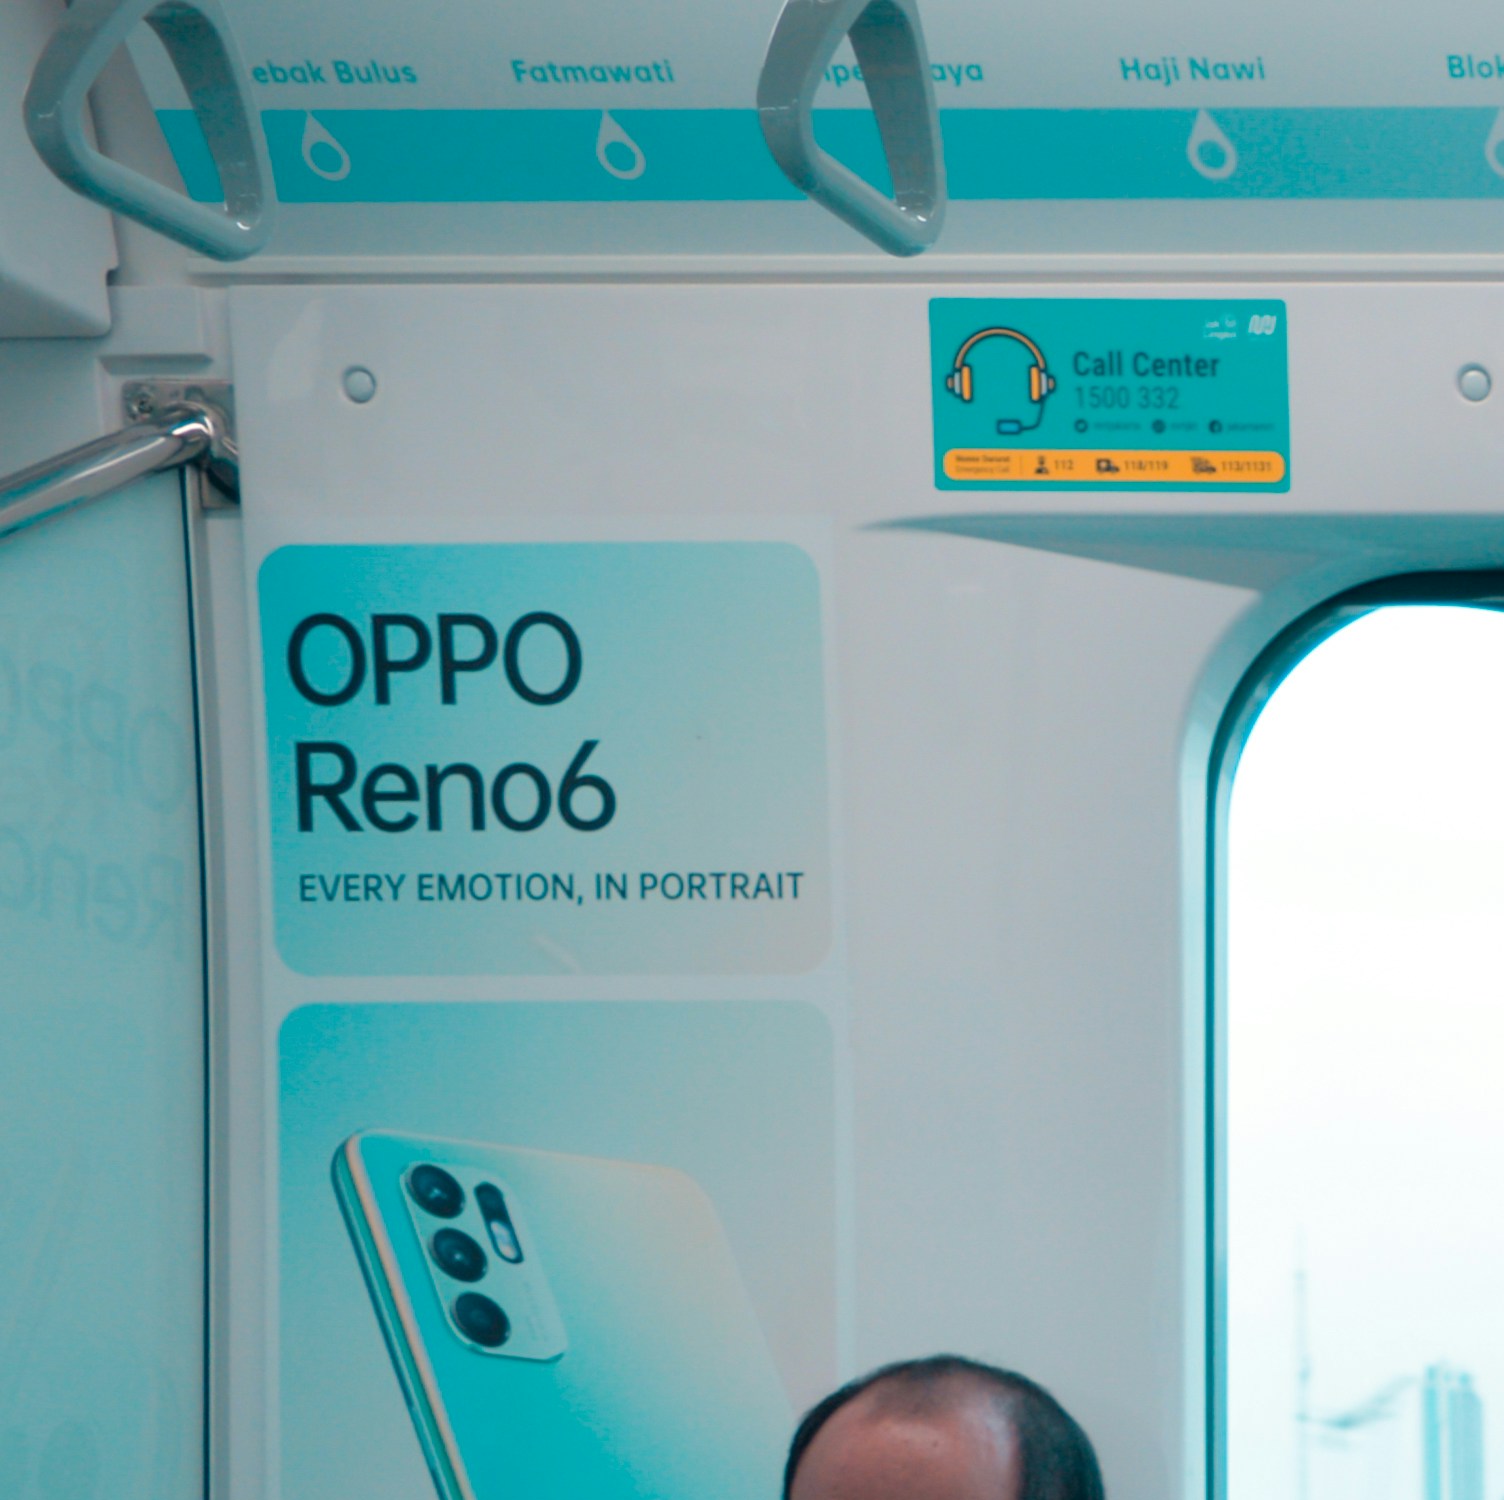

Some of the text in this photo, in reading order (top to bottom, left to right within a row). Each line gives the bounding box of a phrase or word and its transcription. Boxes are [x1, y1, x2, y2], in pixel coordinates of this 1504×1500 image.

[332, 59, 417, 84] Bulus
[510, 59, 674, 83] Fatmawati
[1120, 57, 1264, 86] Haji Nawi
[1073, 351, 1220, 377] Call Center
[1075, 386, 1180, 409] 1500 332
[286, 612, 582, 708] OPPO
[294, 739, 616, 833] Reno6
[299, 872, 803, 905] EVERY EMOTION, IN PORTRAIT
